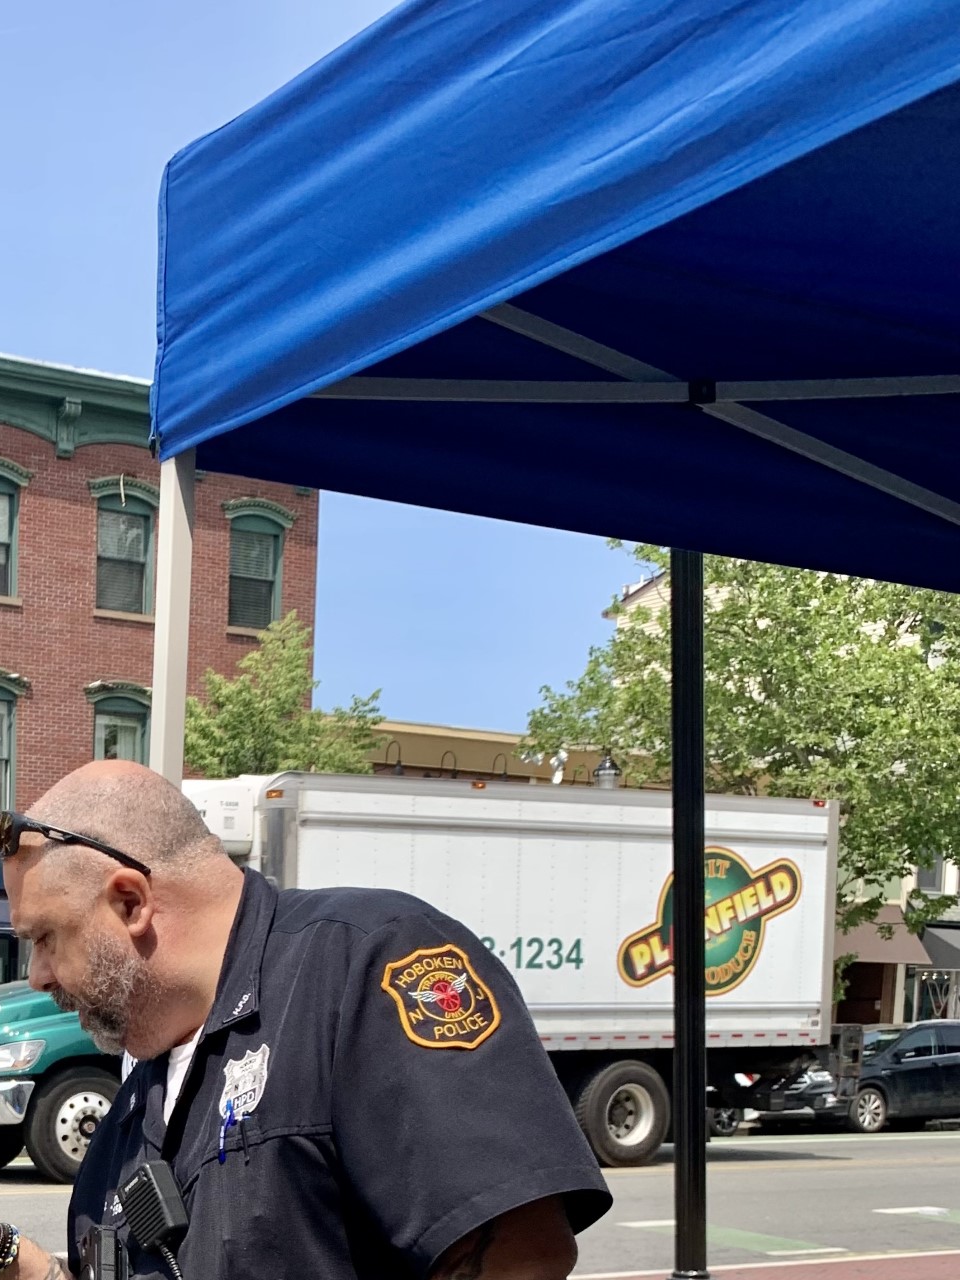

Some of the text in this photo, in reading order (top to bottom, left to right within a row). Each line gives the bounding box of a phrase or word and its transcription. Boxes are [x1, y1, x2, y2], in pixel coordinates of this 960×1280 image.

[630, 870, 792, 978] PLNFIELD
[705, 929, 757, 985] ODUCE
[395, 956, 463, 989] HOBOKEN
[421, 973, 454, 991] TRAFFIC
[476, 987, 485, 1001] J
[408, 1008, 424, 1025] N
[444, 1006, 467, 1019] UNIT
[433, 1012, 489, 1040] POLICE
[233, 1090, 256, 1110] HPD
